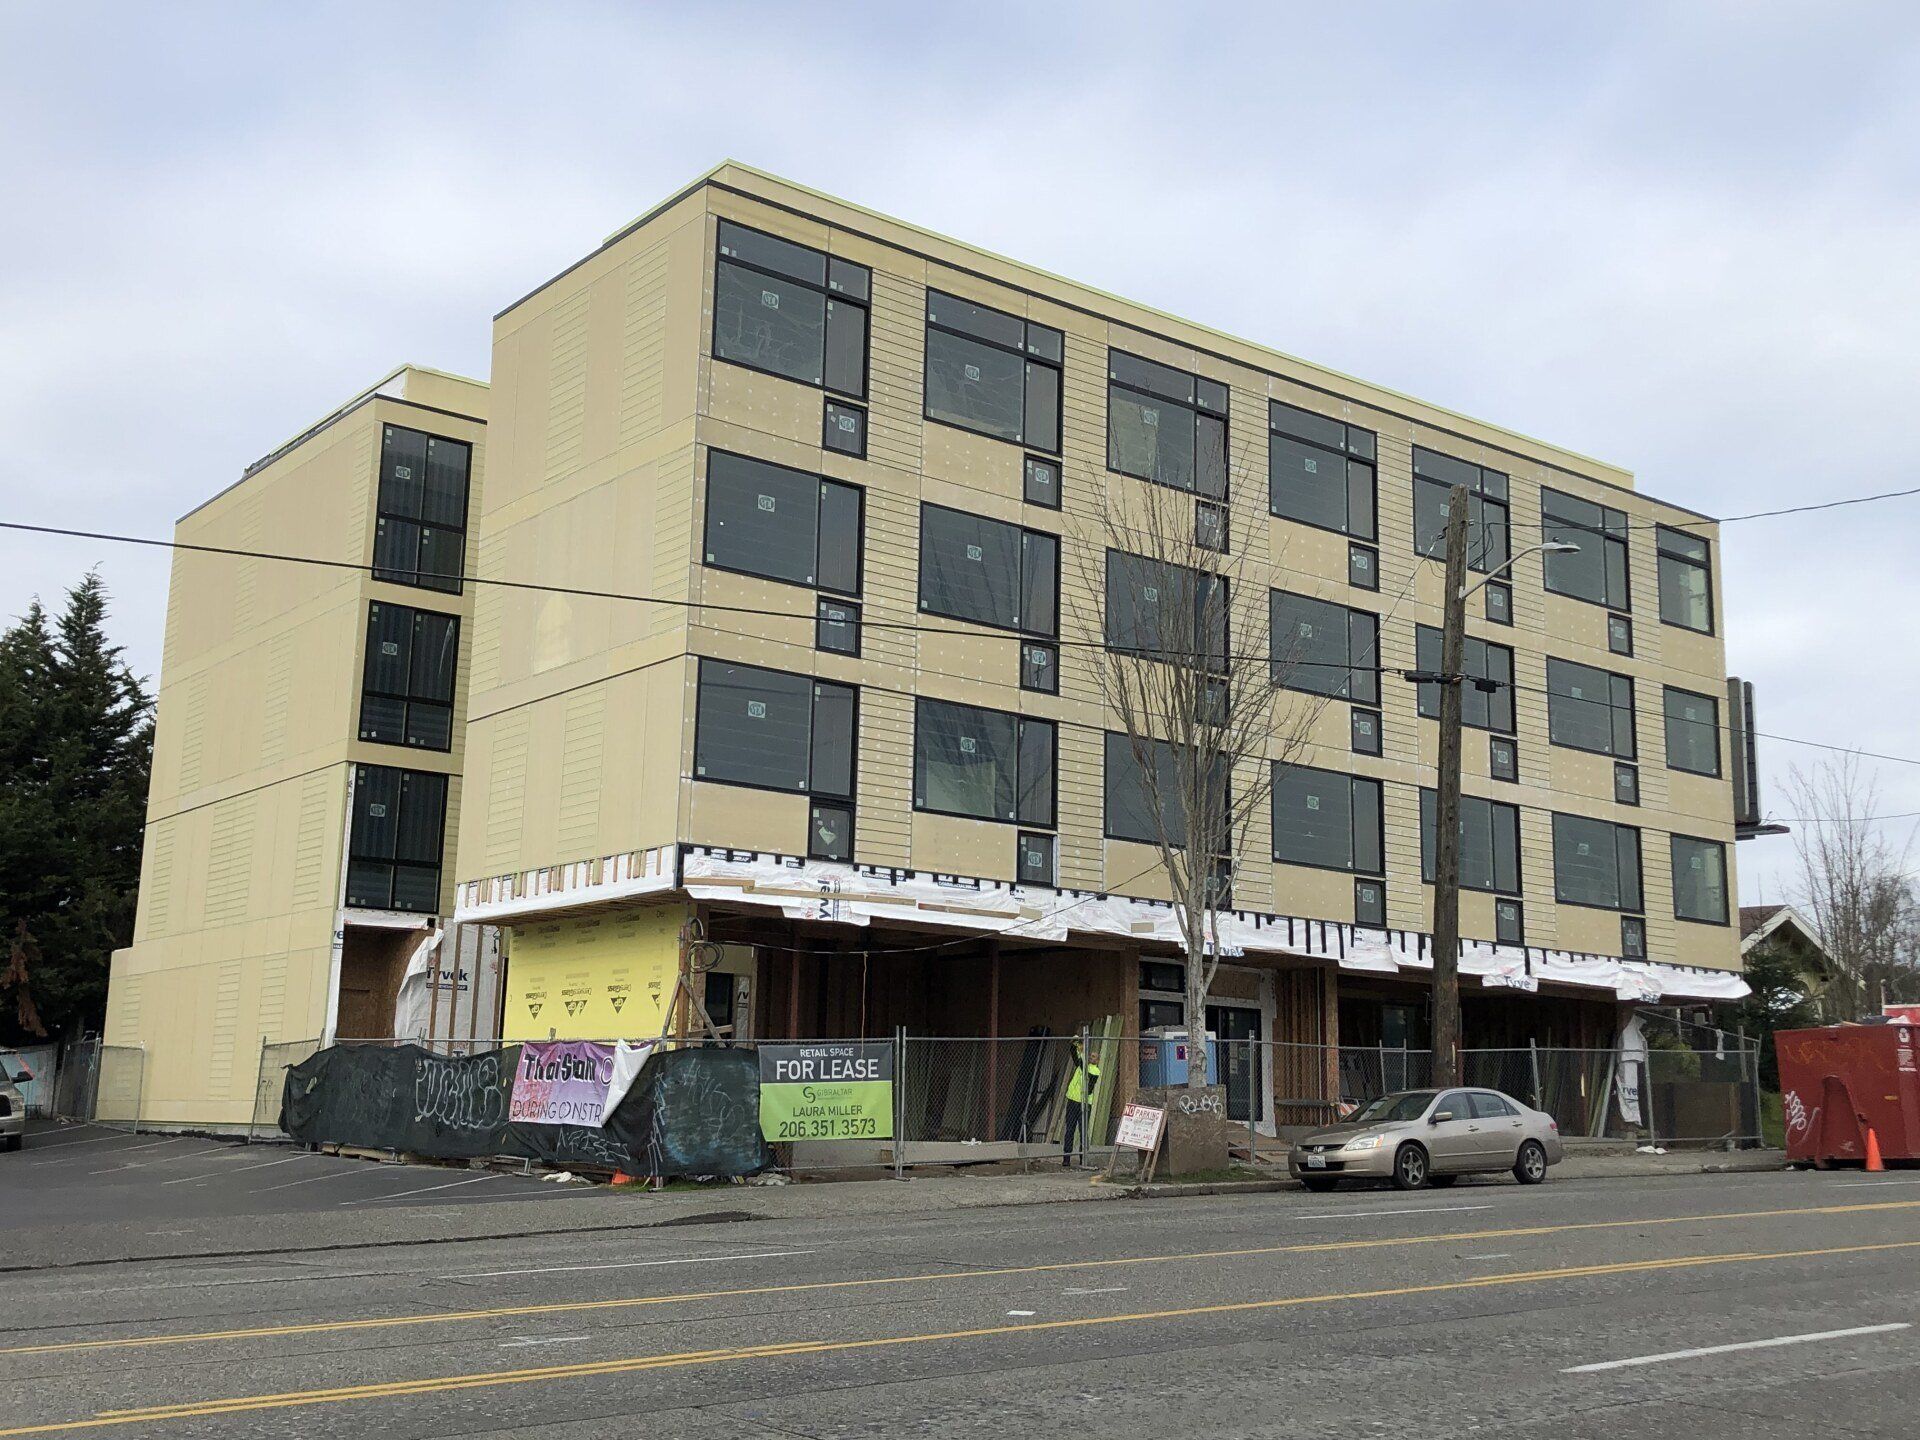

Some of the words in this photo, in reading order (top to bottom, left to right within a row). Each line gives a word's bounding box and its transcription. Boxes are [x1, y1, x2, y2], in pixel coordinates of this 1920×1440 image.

[800, 1048, 828, 1057] RETAIL
[830, 1048, 854, 1057] SPACE
[776, 1060, 814, 1080] FOR
[820, 1059, 879, 1079] LEASE
[817, 1088, 854, 1097] GIBRALTAR
[793, 1106, 826, 1117] LAURA
[828, 1105, 863, 1116] MILLER
[1125, 1105, 1135, 1116] NO
[1136, 1109, 1160, 1120] PARKING
[779, 1118, 876, 1138] 206.351.3573
